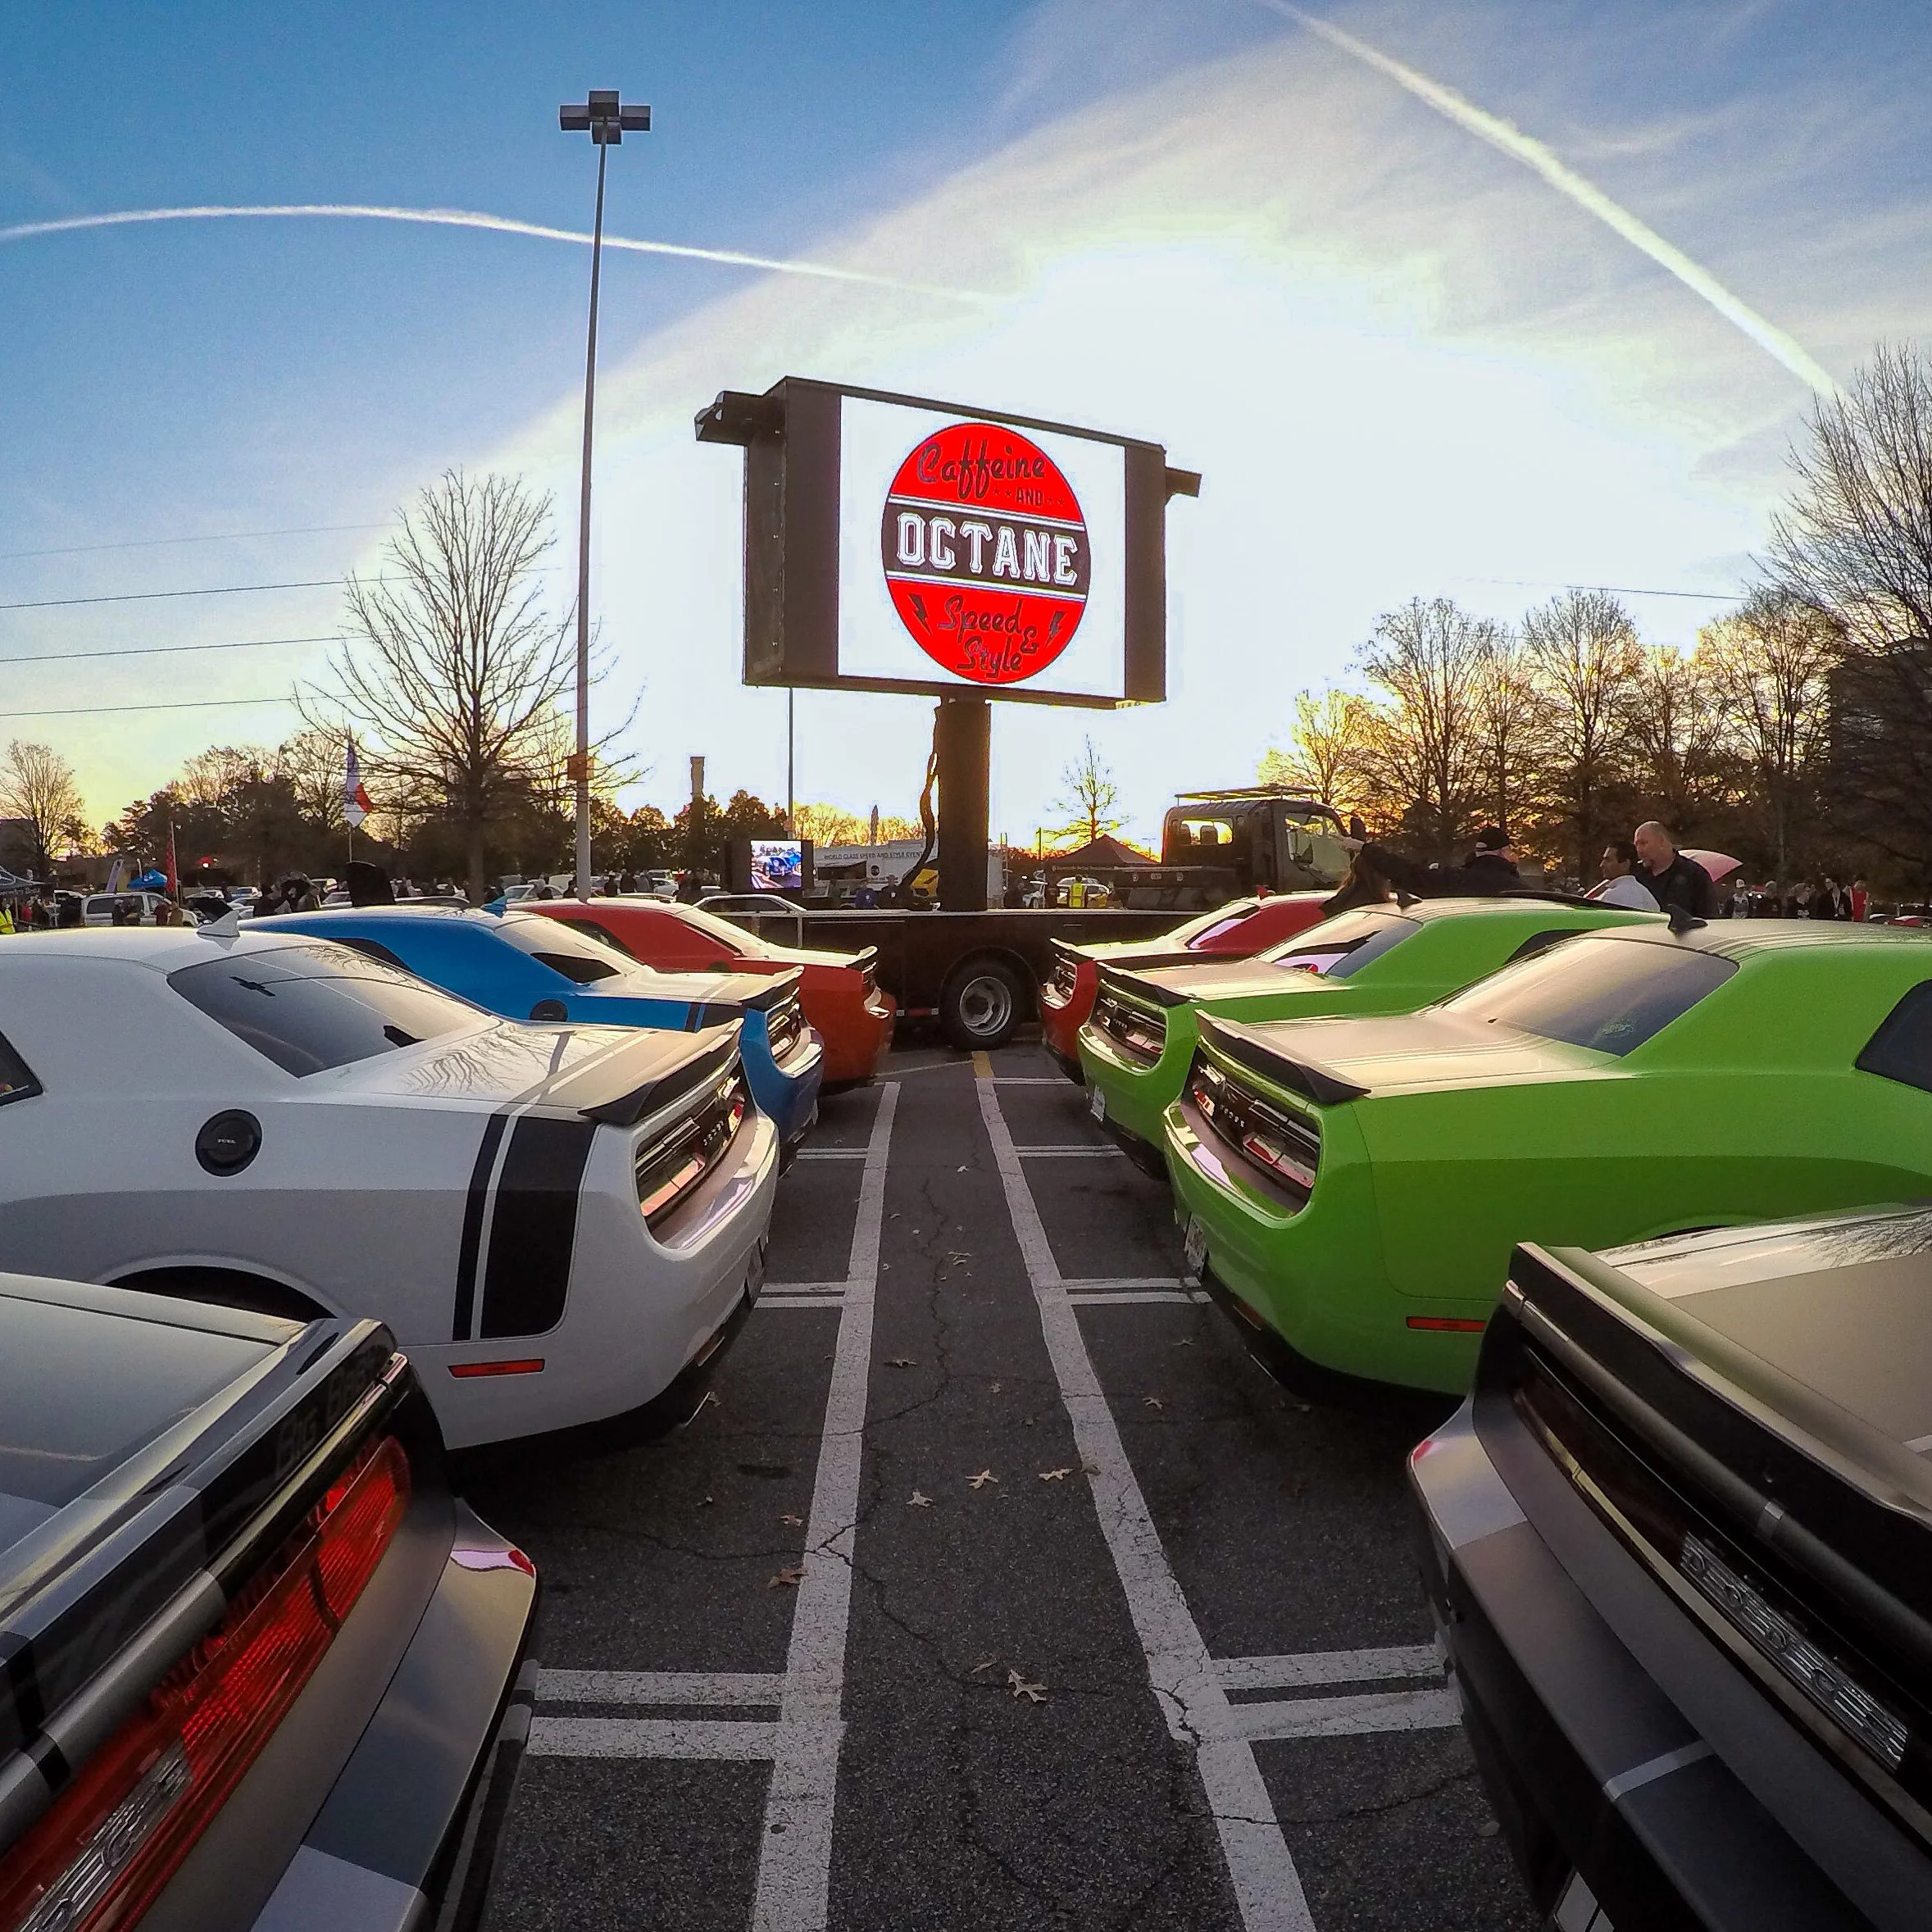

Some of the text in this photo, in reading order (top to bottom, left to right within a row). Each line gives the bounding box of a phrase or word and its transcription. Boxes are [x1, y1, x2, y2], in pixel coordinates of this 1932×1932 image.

[917, 439, 1045, 499] Caffeine
[1016, 489, 1044, 506] AND
[896, 512, 1079, 586] OCTANE
[938, 594, 1039, 653] Speed &
[957, 636, 1022, 679] Style
